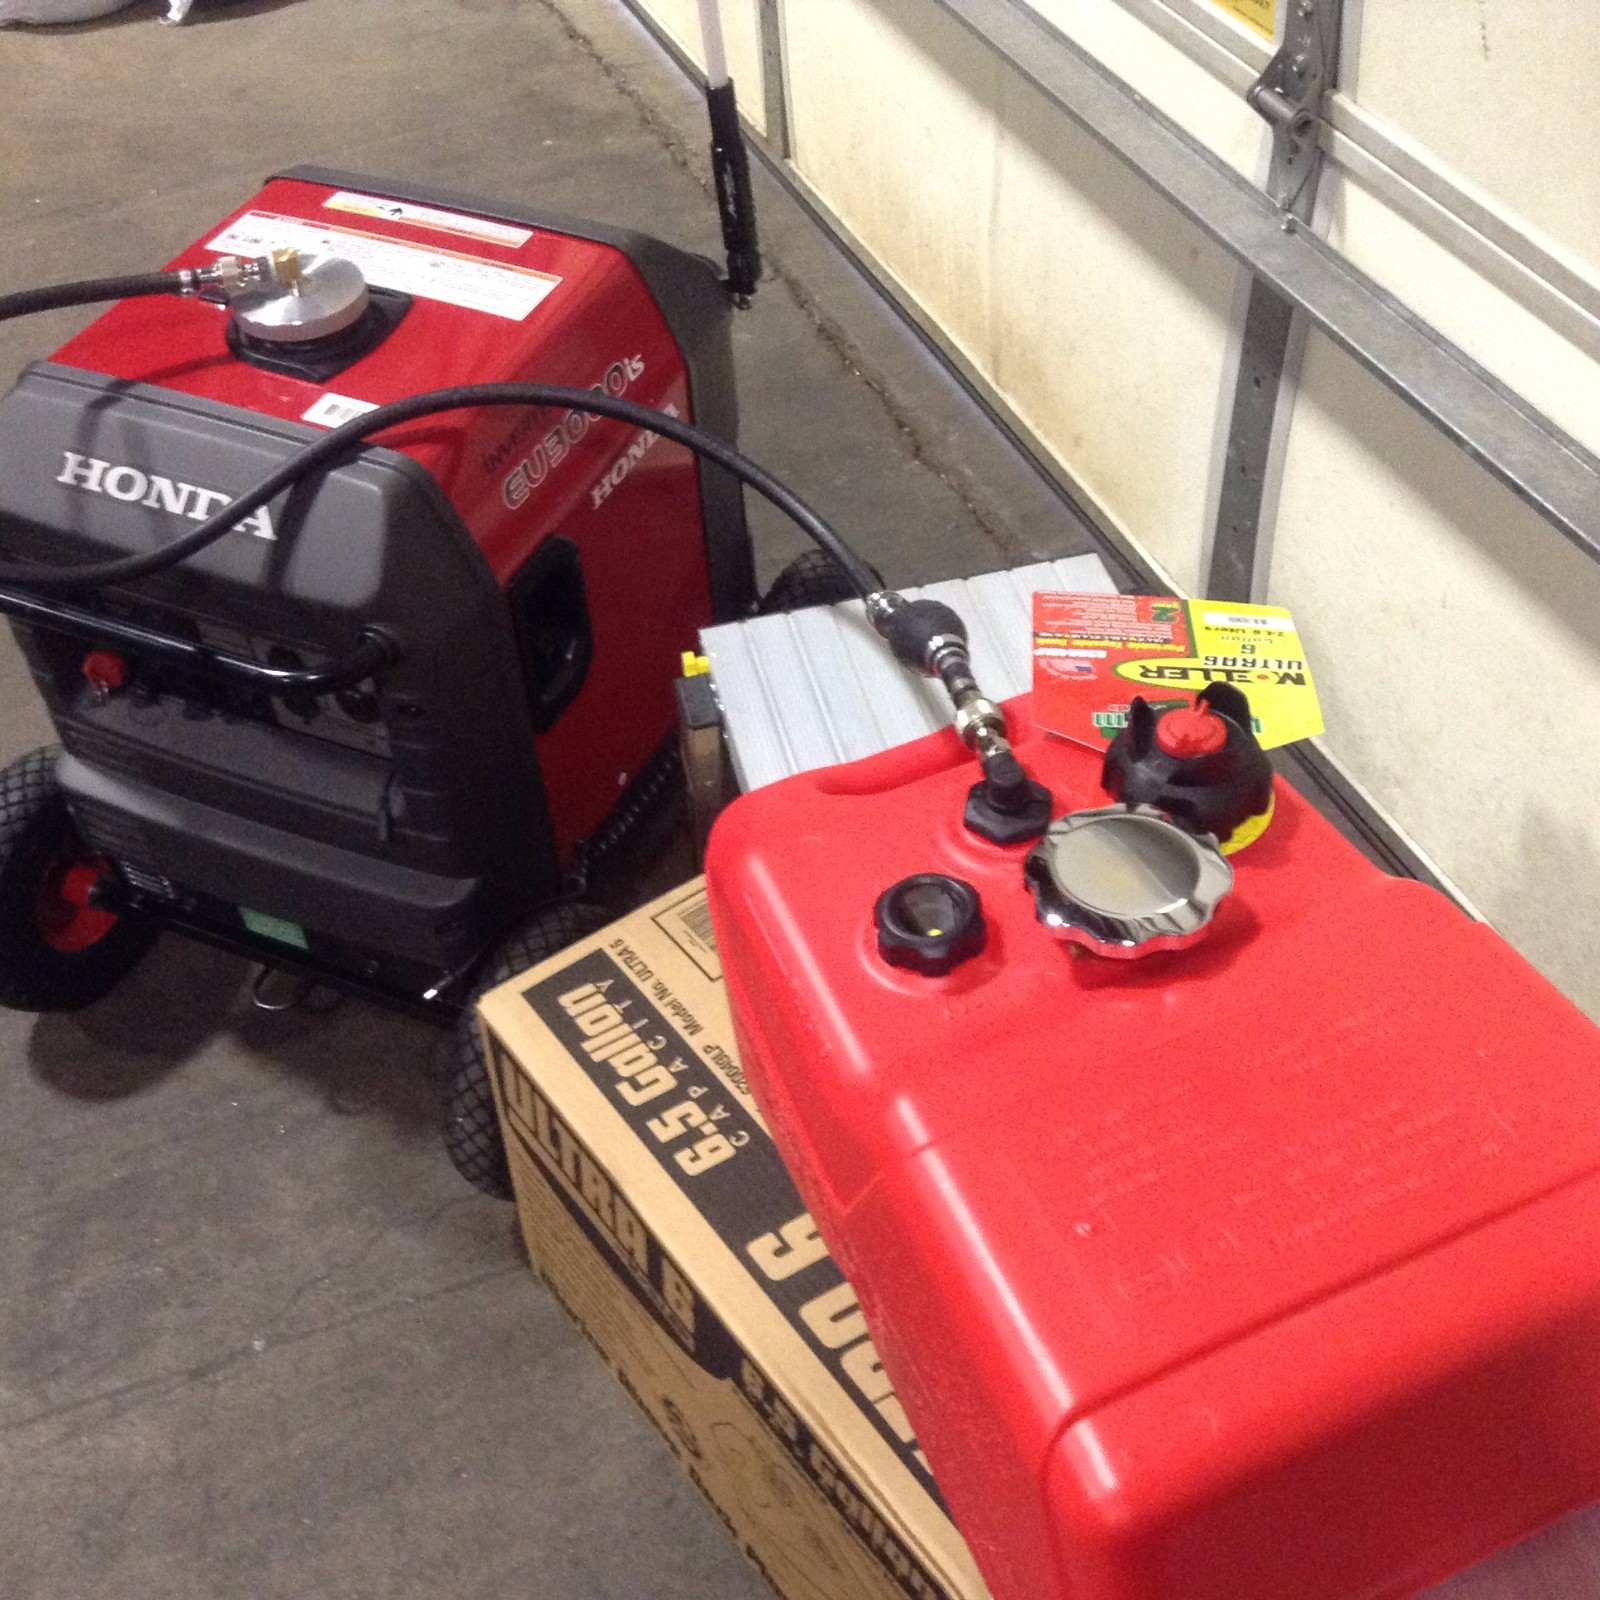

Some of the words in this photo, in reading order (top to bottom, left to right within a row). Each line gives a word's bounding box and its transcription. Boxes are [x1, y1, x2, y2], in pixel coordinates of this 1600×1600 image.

[609, 938, 625, 950] 6
[617, 945, 654, 983] ULTRA
[652, 975, 673, 1002] No.
[557, 983, 678, 1107] Gallon
[664, 999, 704, 1037] Model
[597, 979, 751, 1147] CAPACITY
[645, 1100, 737, 1176] 6.5
[502, 1050, 649, 1282] ULTRA
[663, 1254, 696, 1334] 6
